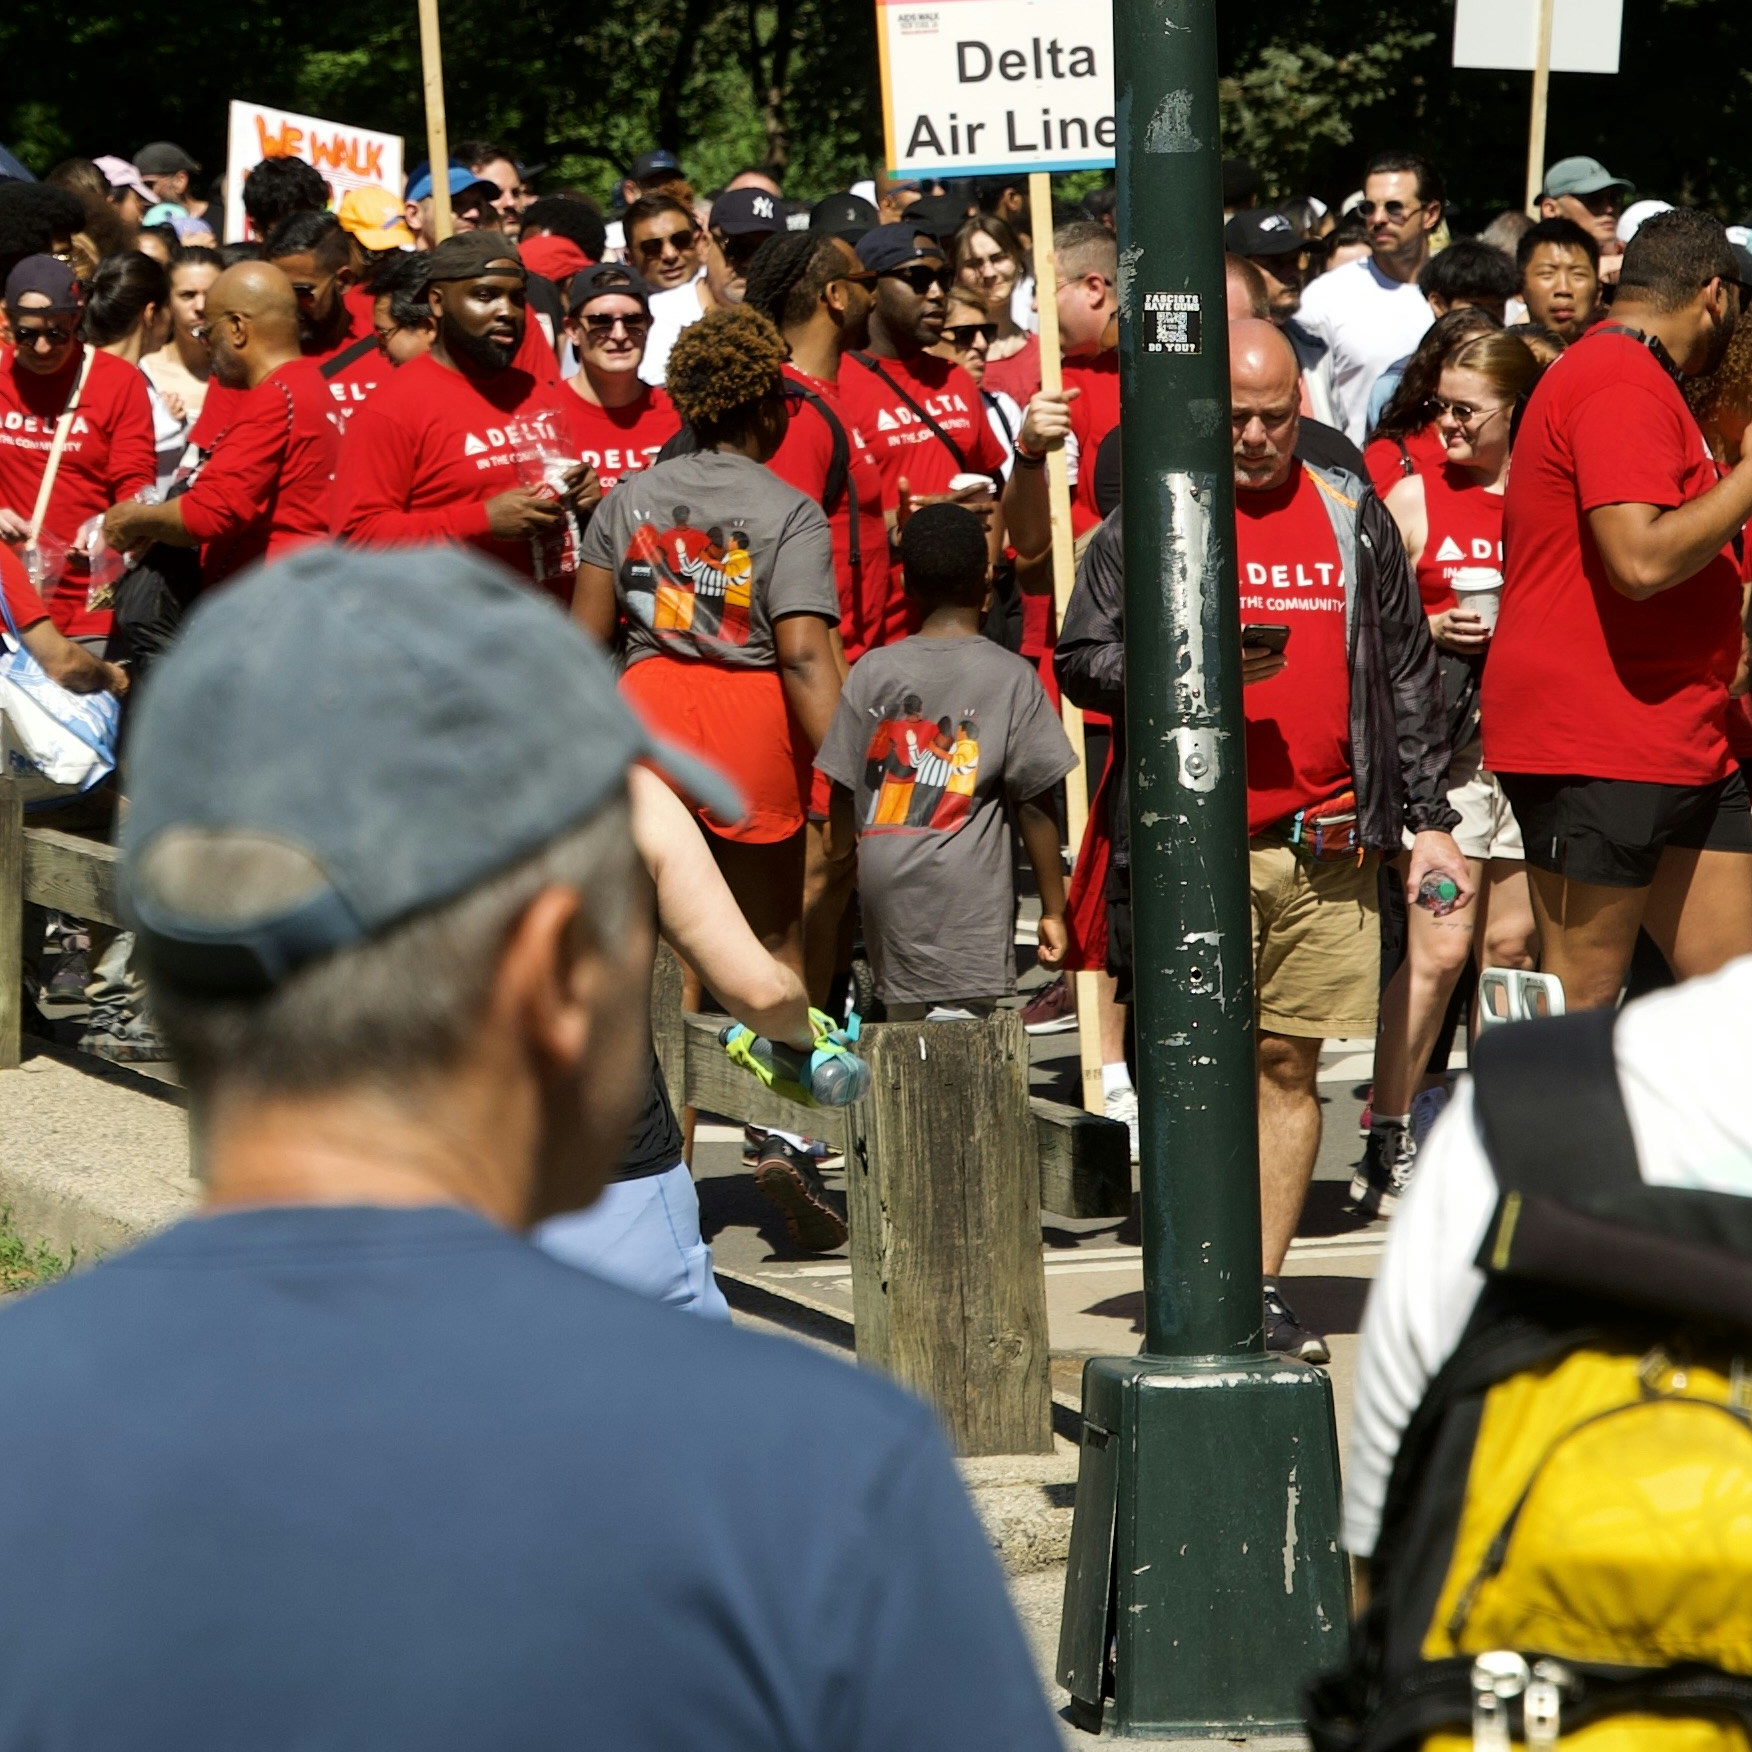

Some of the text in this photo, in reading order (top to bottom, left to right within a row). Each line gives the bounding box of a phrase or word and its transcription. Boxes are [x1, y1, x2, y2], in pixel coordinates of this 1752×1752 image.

[956, 36, 1097, 83] Delta
[255, 112, 384, 180] WE WALK
[905, 108, 1116, 157] Air Line
[1145, 294, 1199, 304] FASCISTS
[1148, 343, 1196, 353] DO YOU?
[1240, 595, 1346, 613] THE COMMUNITY
